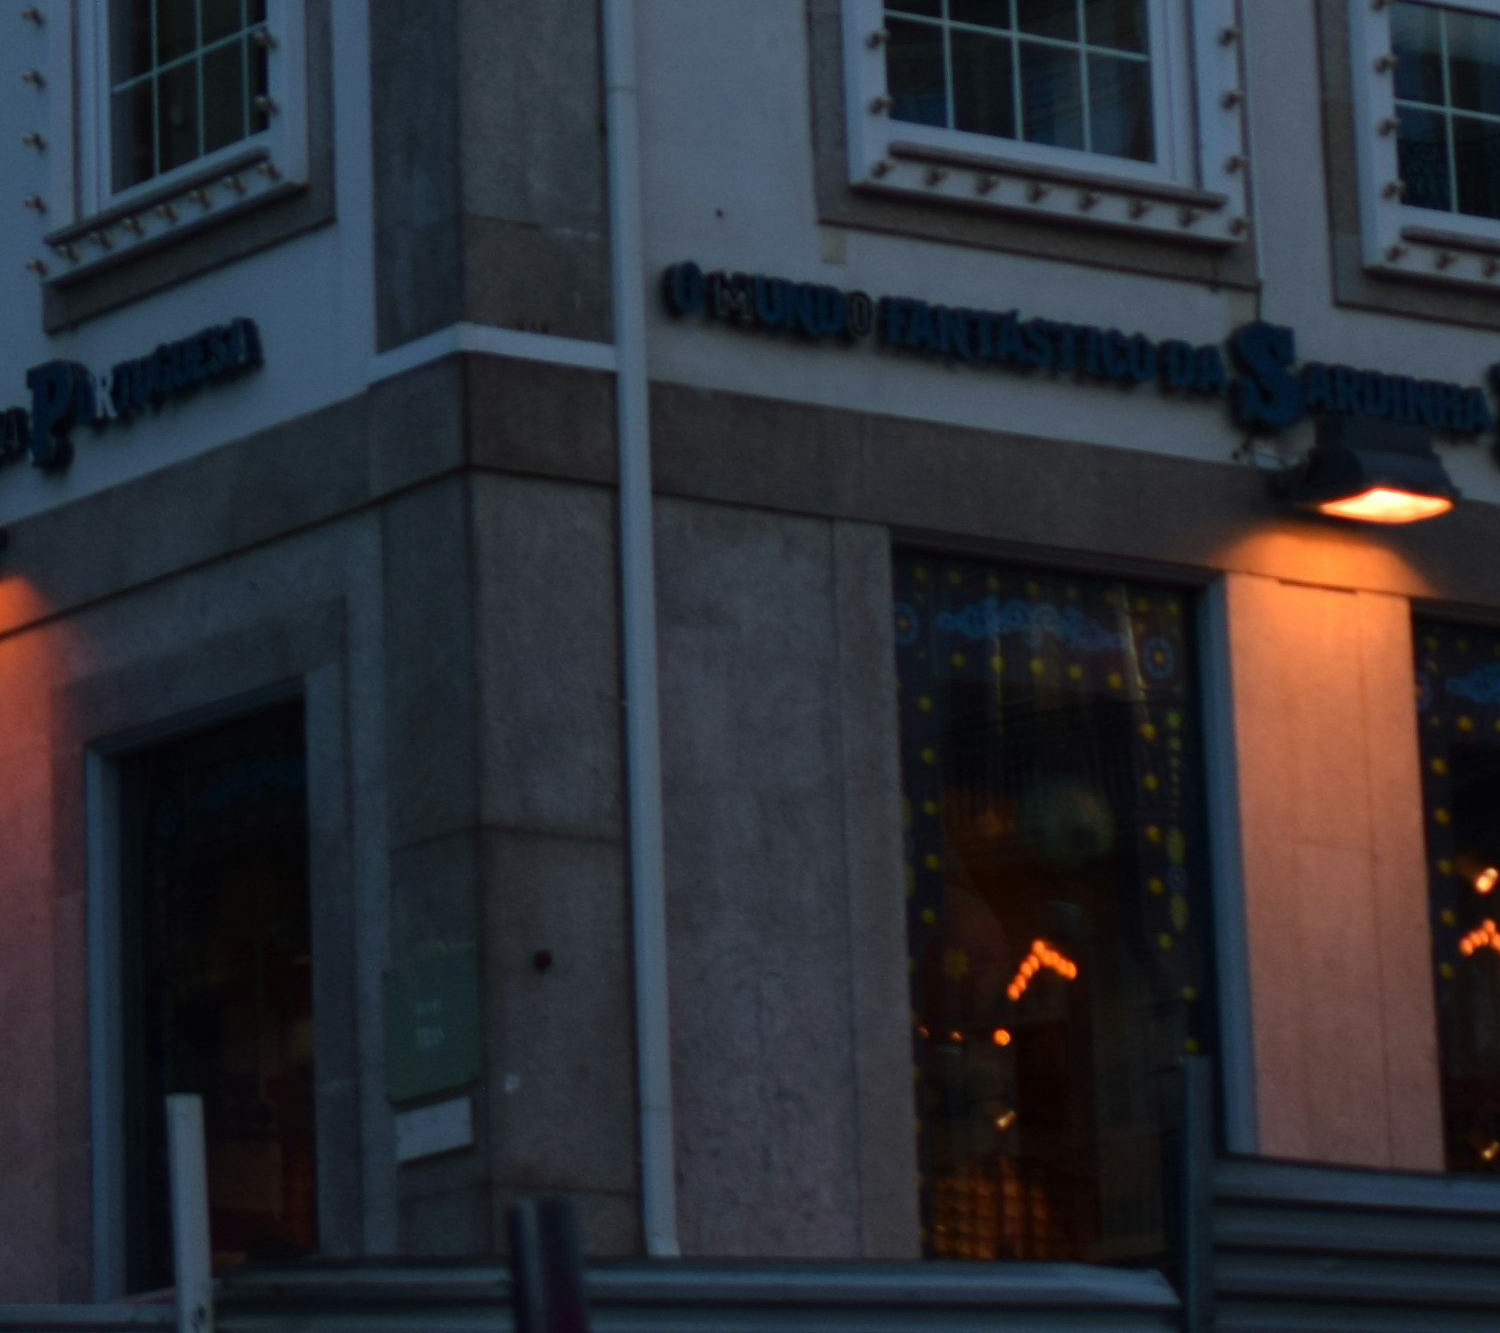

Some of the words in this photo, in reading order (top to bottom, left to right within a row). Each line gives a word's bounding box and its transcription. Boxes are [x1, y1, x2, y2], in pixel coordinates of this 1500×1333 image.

[706, 272, 872, 341] MUNDO
[879, 295, 1157, 386] FANTÁSTICO
[1158, 339, 1227, 395] DA
